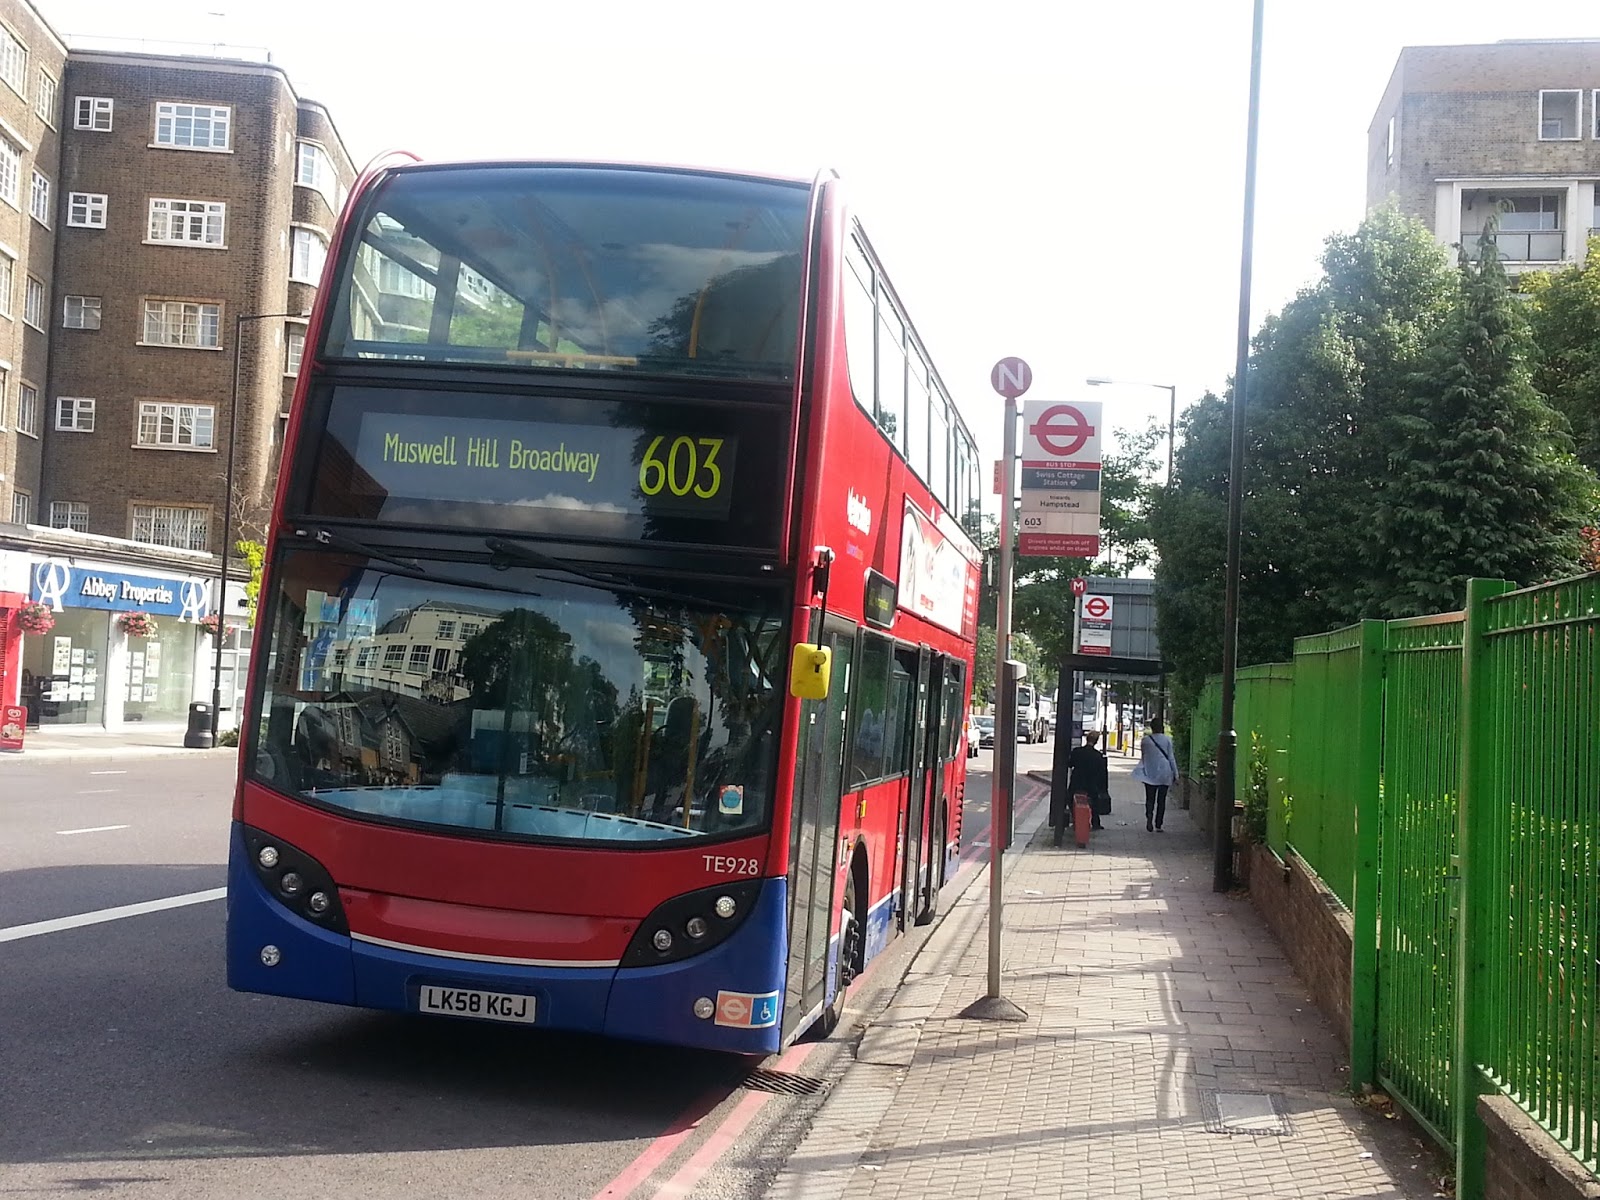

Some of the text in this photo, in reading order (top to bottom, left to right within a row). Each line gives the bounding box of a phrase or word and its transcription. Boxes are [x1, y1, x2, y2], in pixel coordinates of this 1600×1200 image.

[998, 363, 1024, 390] N
[383, 432, 600, 482] Muswell Hill Broadway
[639, 435, 724, 499] 603
[1057, 472, 1085, 480] Cottage
[1024, 518, 1042, 526] 603
[81, 575, 173, 606] Abbey Properties
[1073, 581, 1084, 591] M
[702, 855, 759, 876] TE928
[427, 988, 527, 1018] LK58 KGJ
